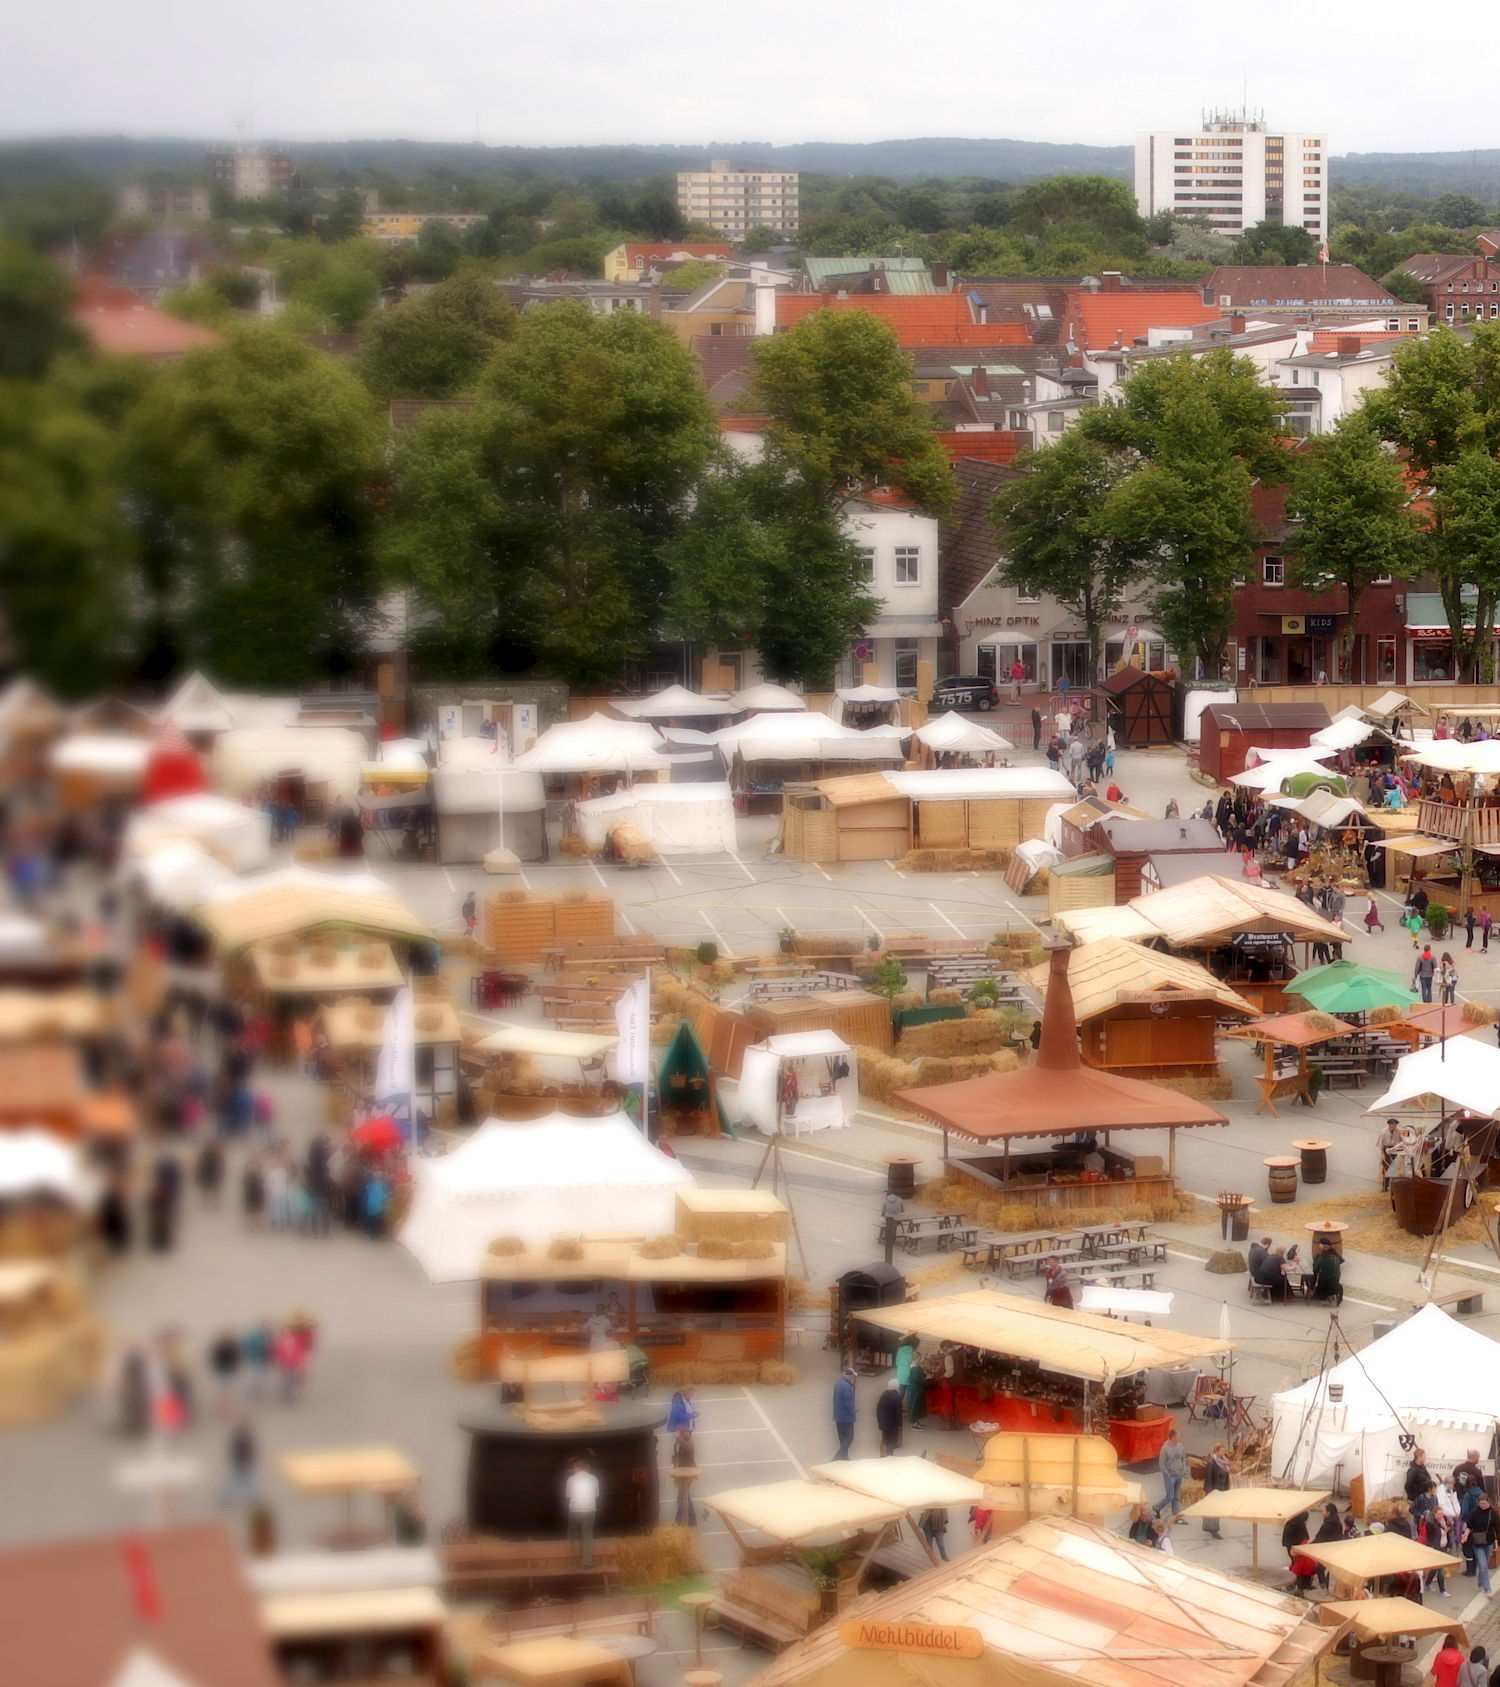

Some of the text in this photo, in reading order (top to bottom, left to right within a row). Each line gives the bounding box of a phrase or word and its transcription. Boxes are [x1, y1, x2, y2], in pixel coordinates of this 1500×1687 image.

[975, 615, 1041, 626] HINZ OPTIK
[1310, 618, 1332, 627] KIDS
[938, 690, 973, 706] 7575
[858, 1625, 962, 1651] Mehlbüddel
